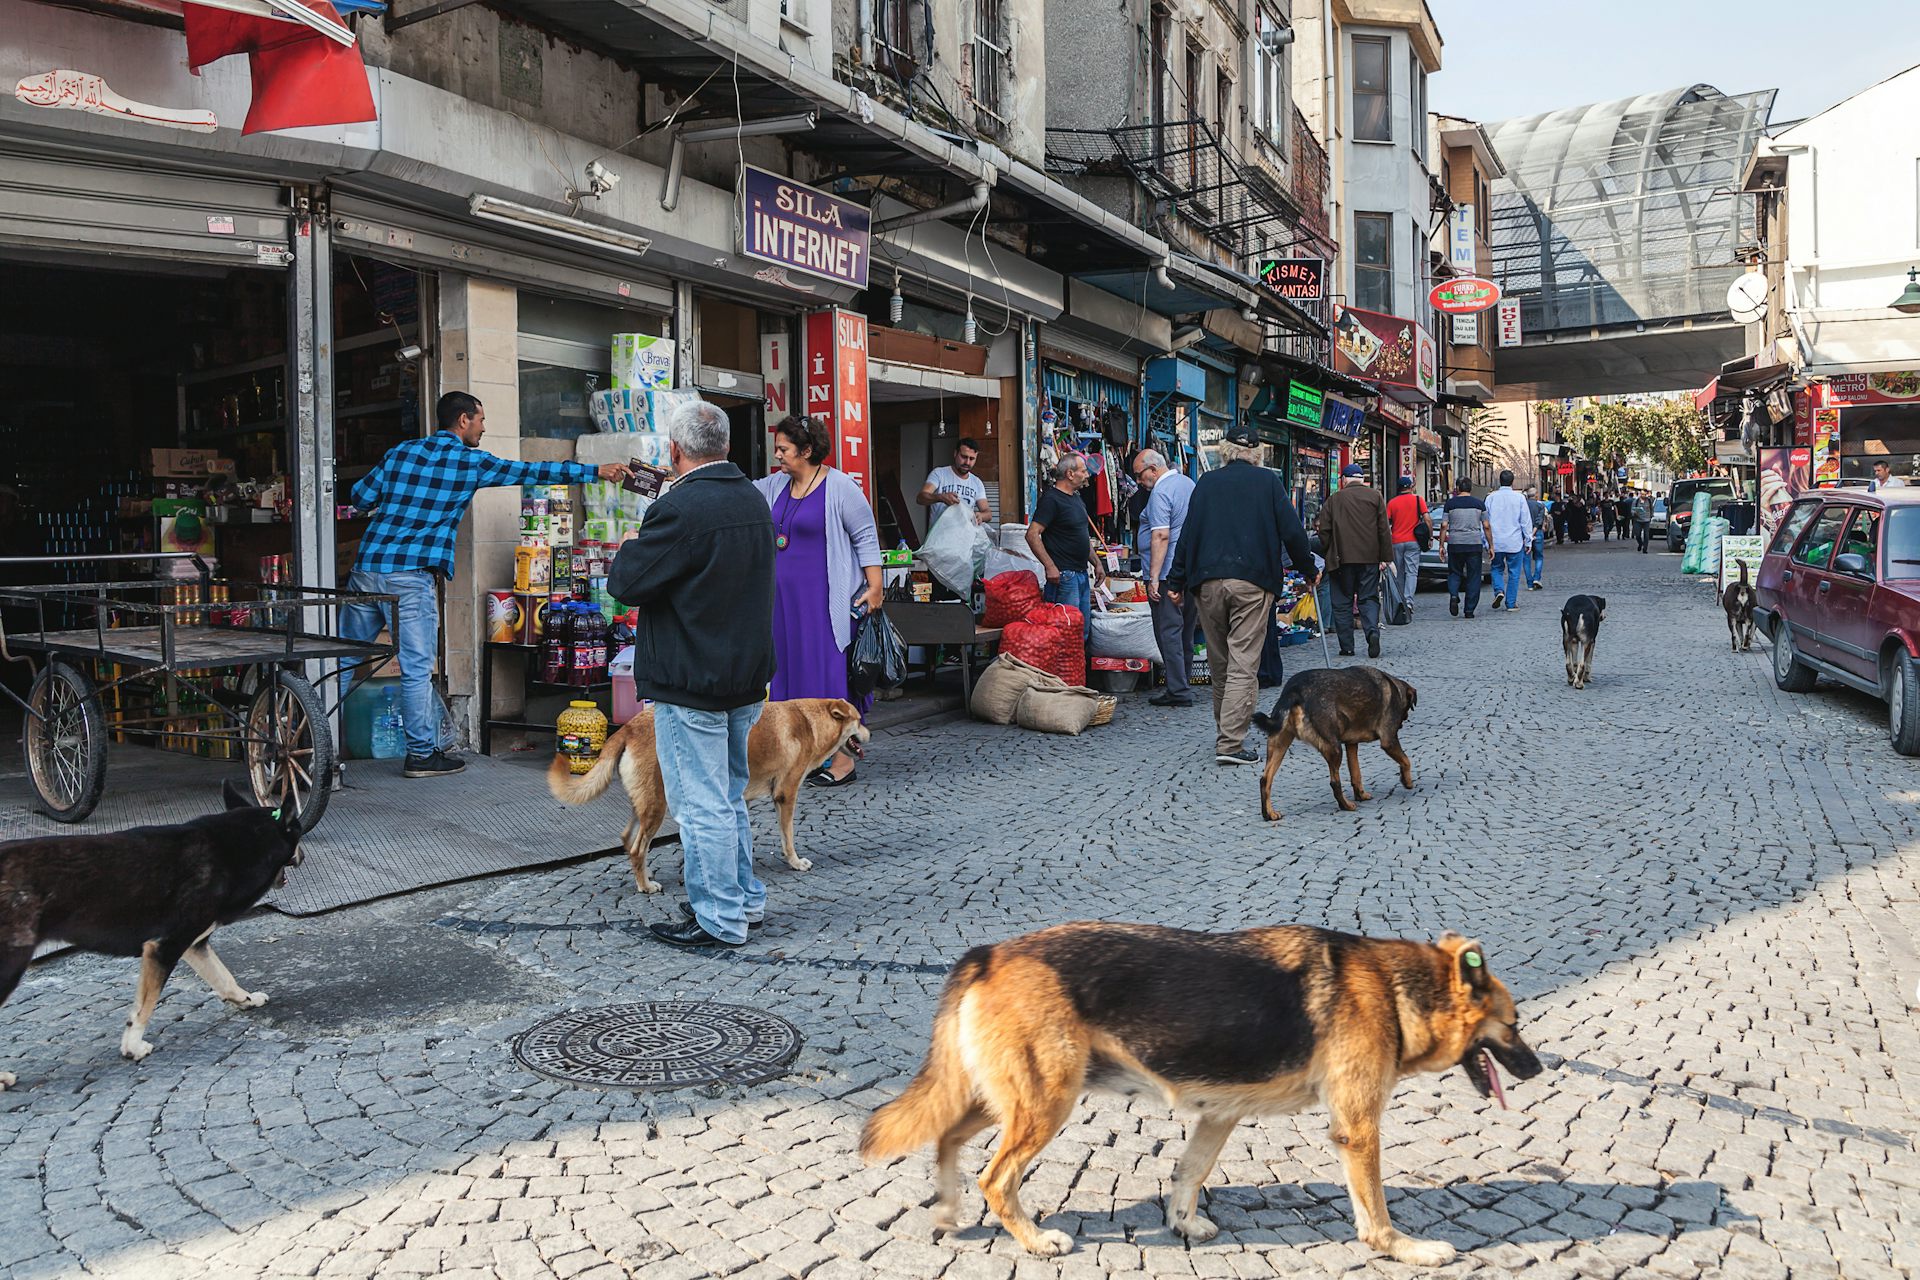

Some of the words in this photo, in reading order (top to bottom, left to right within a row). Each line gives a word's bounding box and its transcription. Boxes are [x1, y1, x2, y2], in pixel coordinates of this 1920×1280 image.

[775, 184, 844, 230] SILA
[754, 200, 861, 279] İNTERNET
[1266, 264, 1317, 285] KISMET
[1266, 284, 1319, 298] KANTASI
[839, 316, 865, 351] SILA
[1502, 307, 1517, 340] HOTEL
[1832, 384, 1866, 392] METRO
[941, 484, 977, 498] HILFIGE
